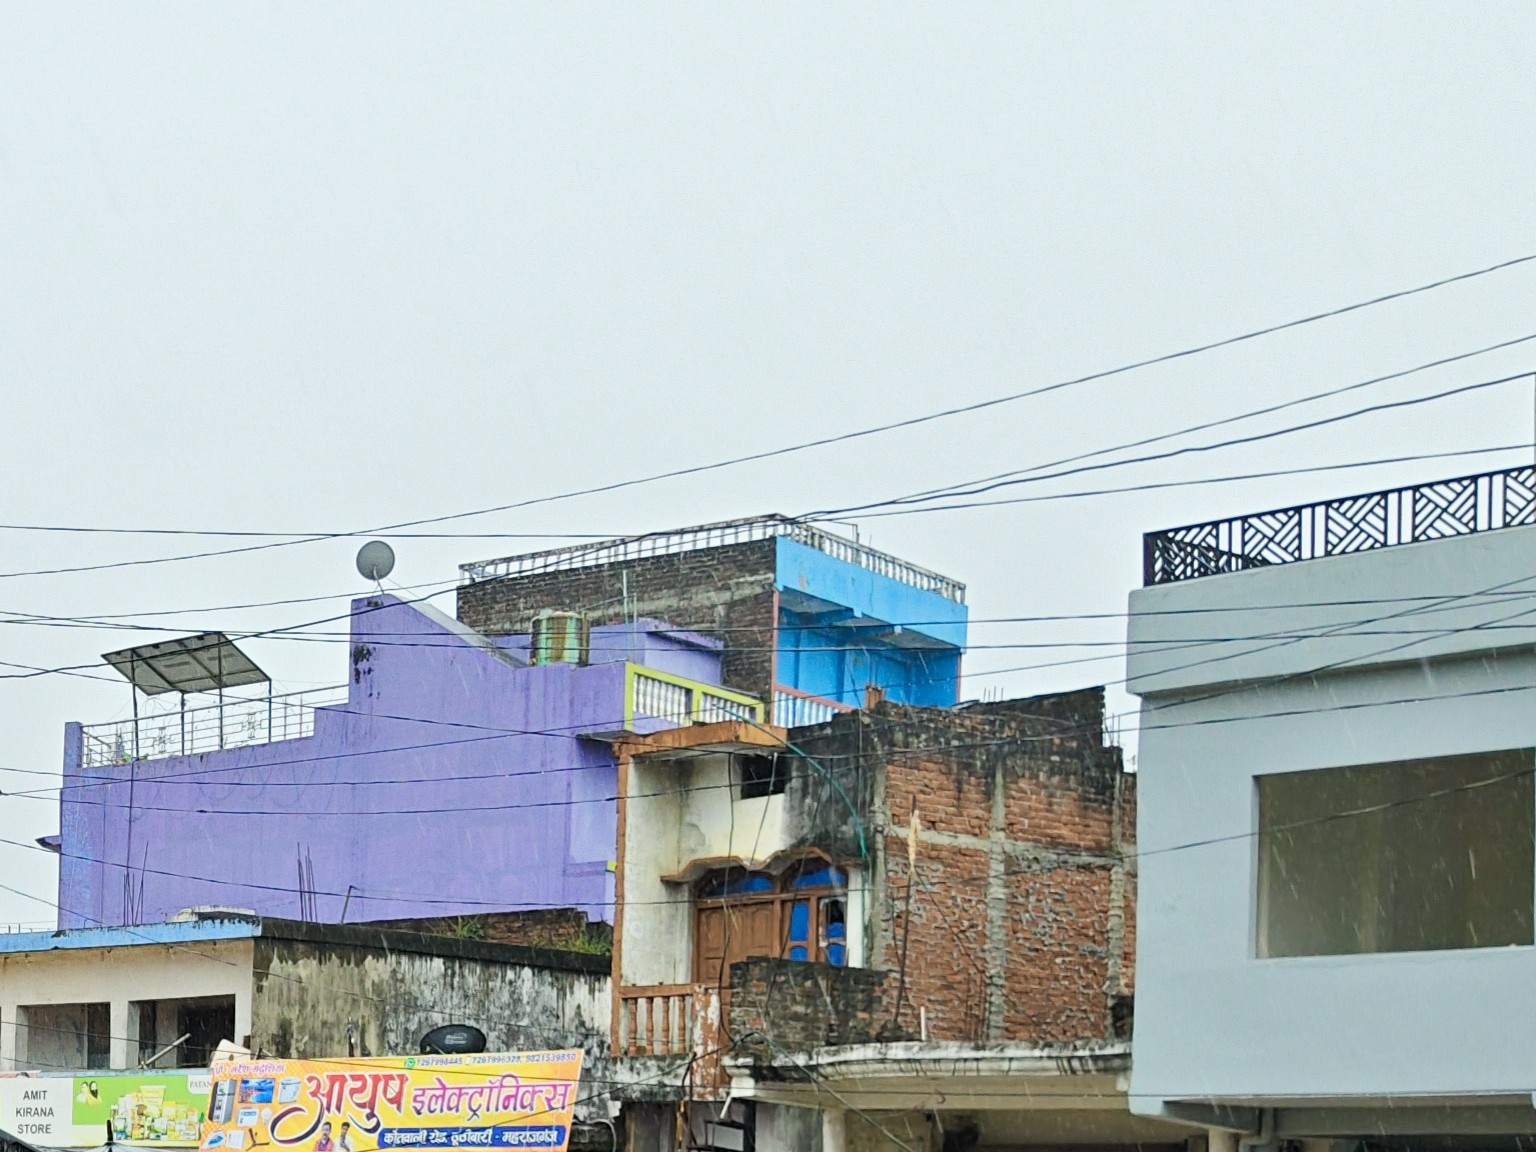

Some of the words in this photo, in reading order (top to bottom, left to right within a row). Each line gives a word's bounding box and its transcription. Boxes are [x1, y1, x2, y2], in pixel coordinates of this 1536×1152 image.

[23, 1090, 48, 1101] AMIT
[15, 1106, 55, 1118] KIRANA
[271, 1074, 409, 1144] आयुष
[17, 1123, 52, 1135] STORE
[383, 1129, 428, 1145] कोतवाली
